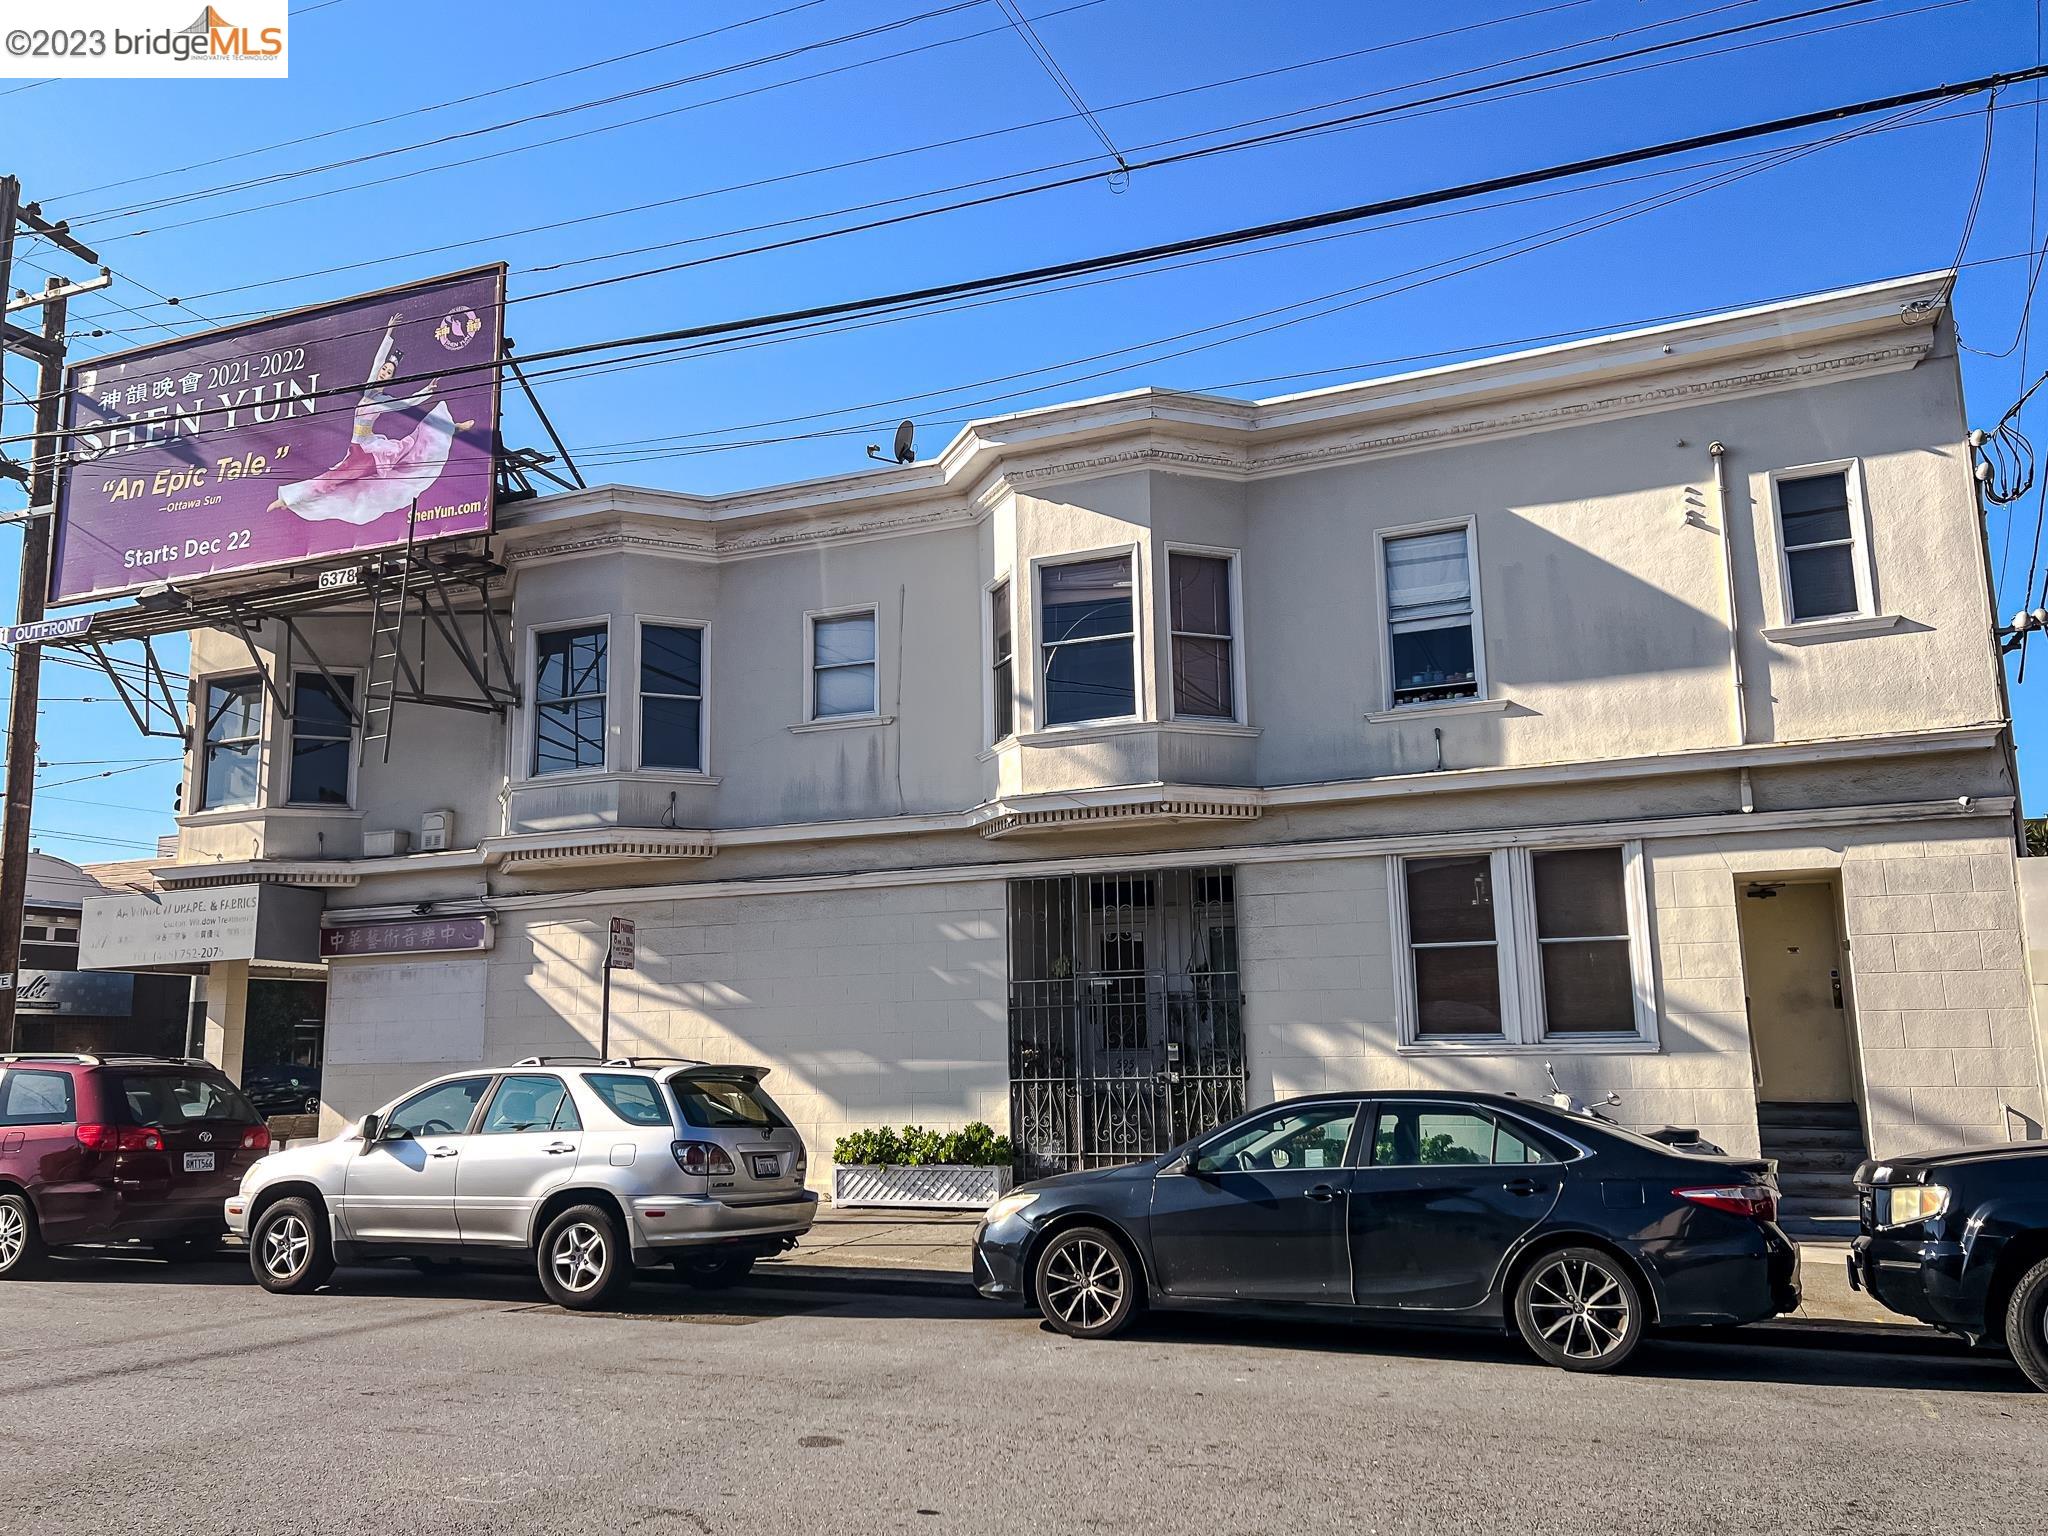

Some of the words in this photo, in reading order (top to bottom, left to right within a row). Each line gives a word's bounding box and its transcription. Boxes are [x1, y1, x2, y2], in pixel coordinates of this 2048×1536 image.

[98, 371, 204, 412] 神韻晚會
[207, 348, 305, 390] 2021-2022
[78, 397, 205, 461] SHEN
[217, 373, 321, 432] YUN
[151, 464, 208, 497] Epic
[203, 494, 222, 506] Sun
[124, 544, 178, 569] Starts
[184, 537, 221, 559] Dec
[227, 529, 252, 551] 22
[320, 568, 356, 587] 6378
[15, 617, 84, 640] OUTFRONT
[210, 901, 218, 911] &
[220, 896, 258, 911] FABRICS
[330, 924, 476, 952] 中華藝術音樂中心
